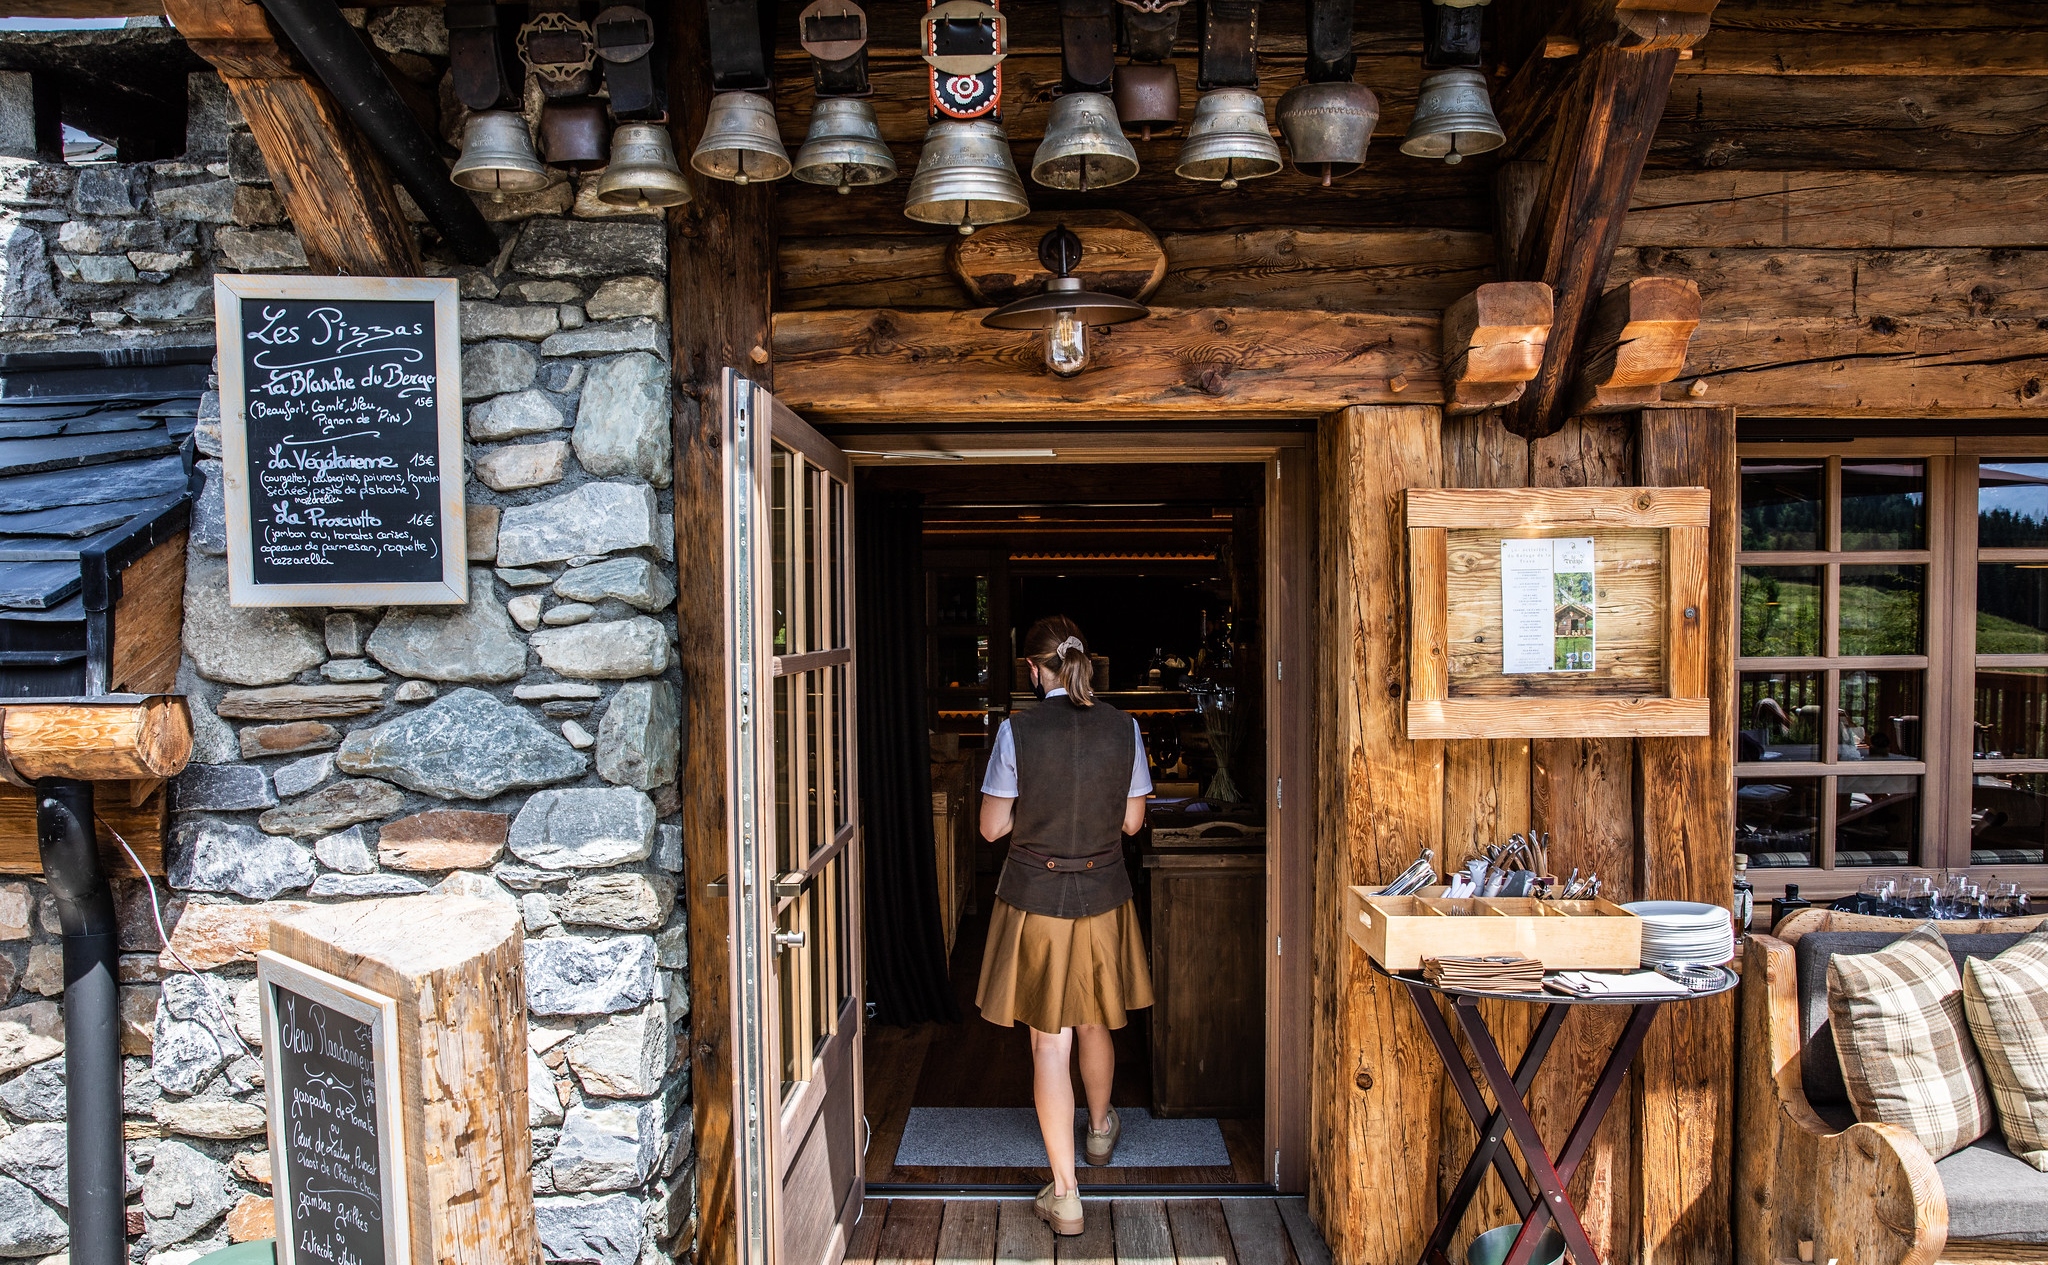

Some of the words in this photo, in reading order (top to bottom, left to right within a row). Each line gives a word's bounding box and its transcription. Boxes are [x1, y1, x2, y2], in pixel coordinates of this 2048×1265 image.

[247, 306, 300, 345] Les
[307, 307, 423, 353] Pizzas
[261, 370, 289, 395] La
[290, 367, 356, 397] Blanche
[361, 365, 382, 387] du
[380, 363, 436, 398] Berger
[249, 400, 309, 421] (Beaufort,
[311, 396, 349, 414] Comté,
[414, 397, 434, 408] 15€
[312, 414, 353, 434] Pignon
[356, 413, 370, 424] de
[268, 444, 296, 470] La
[410, 452, 435, 467] 13€
[345, 484, 357, 494] de
[272, 500, 306, 525] La
[304, 507, 383, 528] Prosciutto
[407, 513, 435, 527] 16€
[265, 525, 307, 545] (jambon
[333, 529, 374, 541] tomates
[264, 553, 335, 565] mozzarella
[304, 541, 319, 551] de
[321, 543, 382, 558] parmesan,
[282, 995, 314, 1054] Menu
[335, 1099, 345, 1120] de
[331, 1124, 339, 1134] ou
[315, 1128, 326, 1156] de
[321, 1158, 330, 1176] de
[336, 1233, 345, 1244] ou
